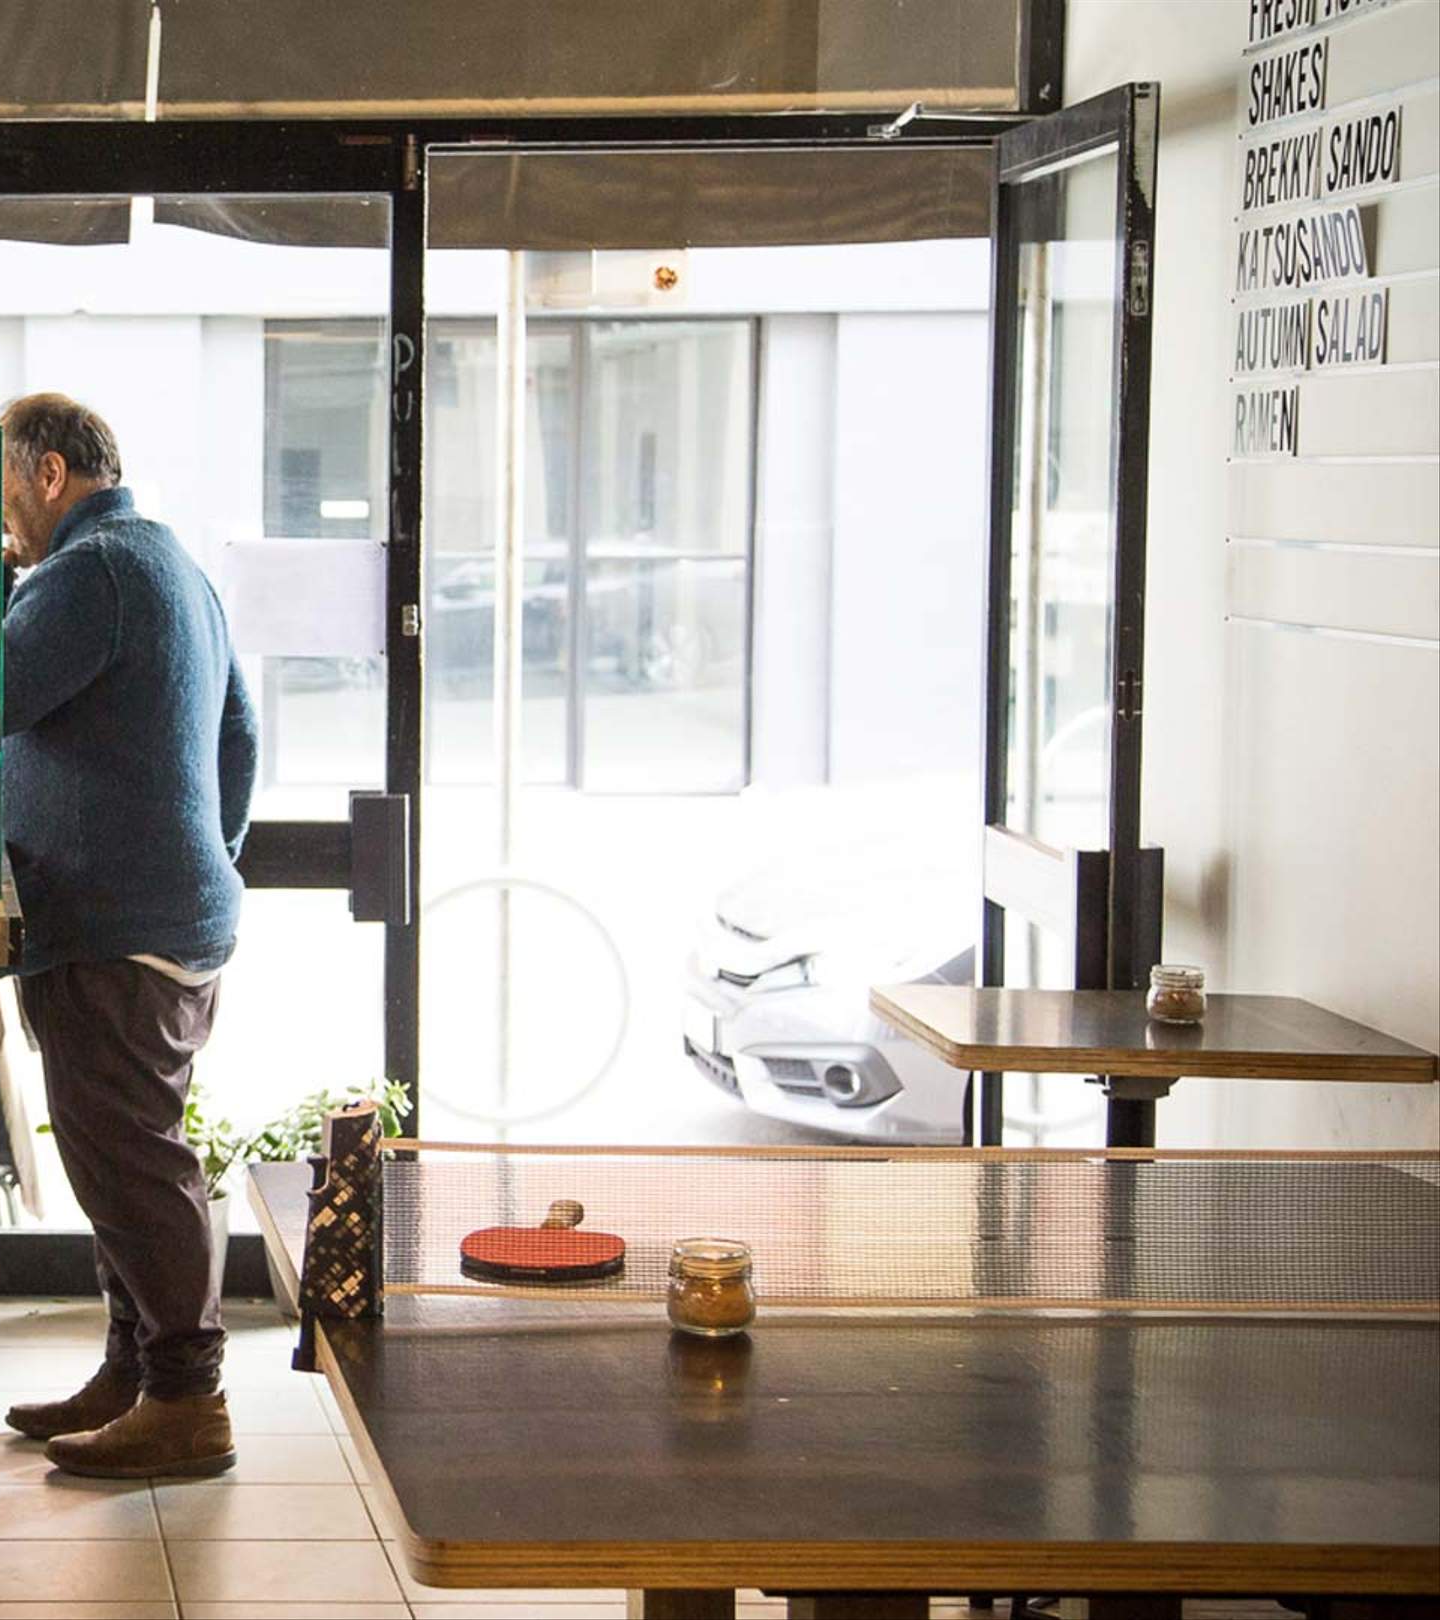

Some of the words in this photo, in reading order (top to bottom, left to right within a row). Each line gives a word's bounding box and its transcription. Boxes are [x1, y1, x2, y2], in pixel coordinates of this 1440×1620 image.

[1248, 42, 1323, 126] SHAKES
[1243, 131, 1318, 211] BREKKY
[1327, 110, 1397, 192] SANDO
[1235, 302, 1308, 372] AUTUMN
[1316, 292, 1383, 365] SALAD
[1234, 388, 1295, 457] RAMEN
